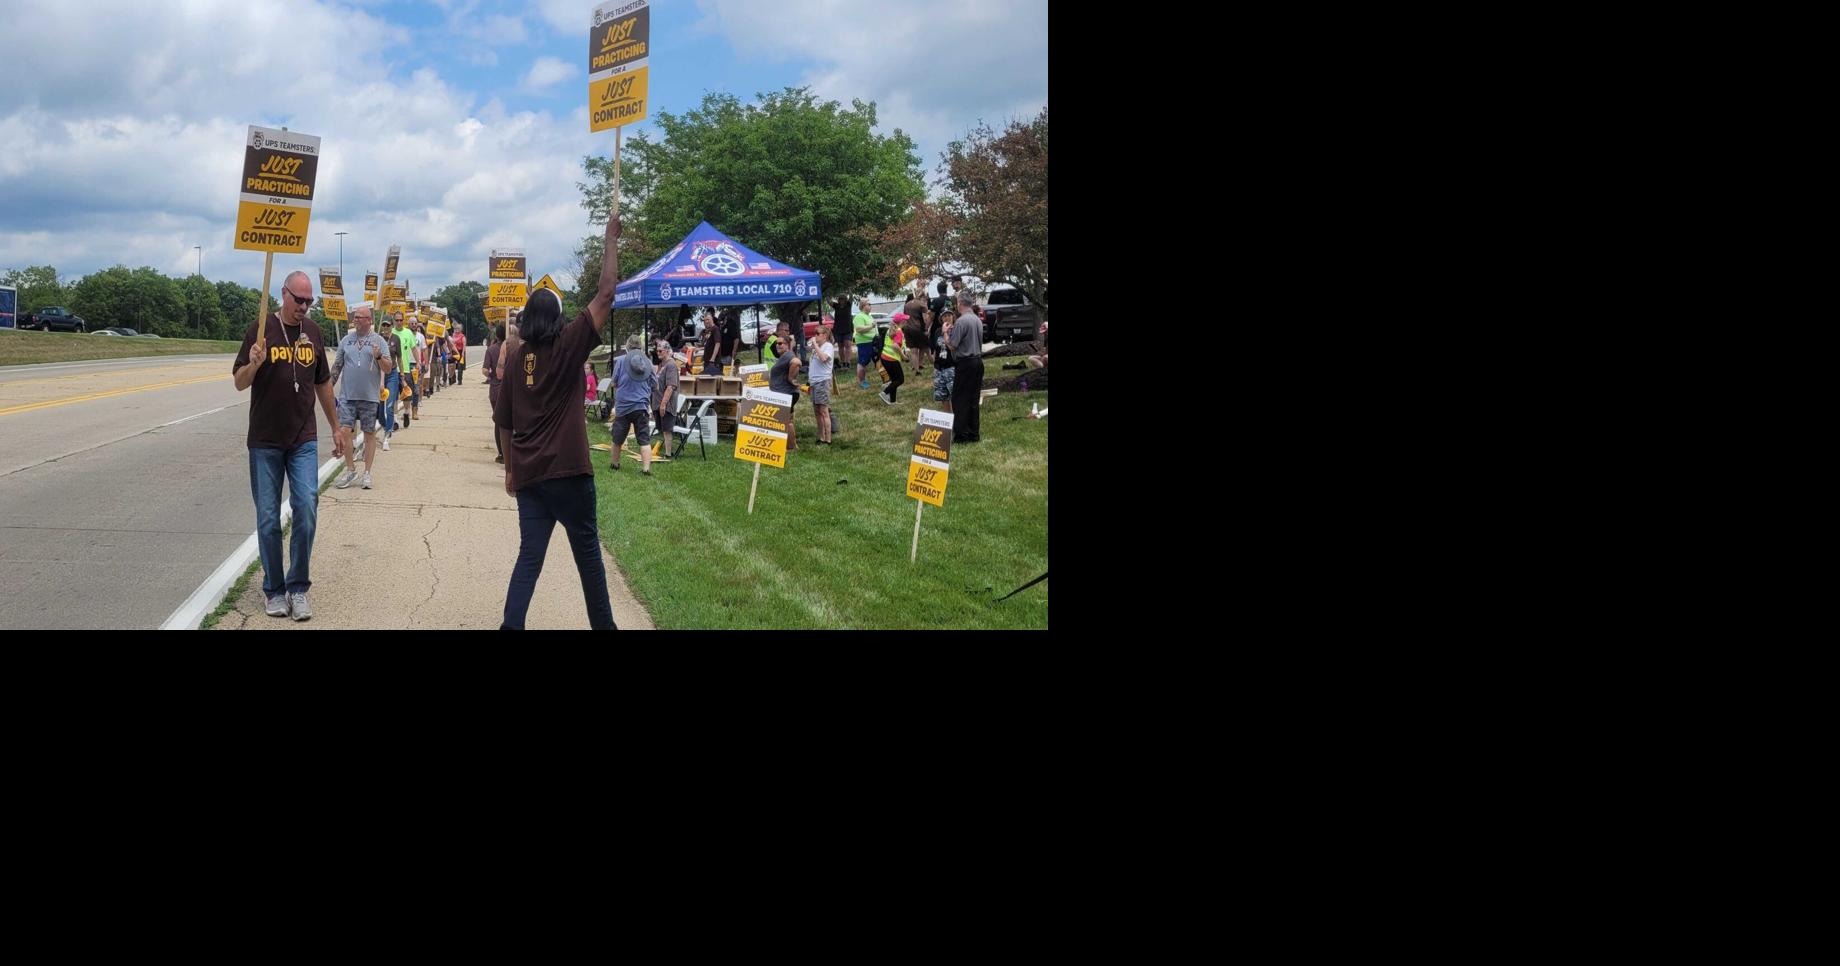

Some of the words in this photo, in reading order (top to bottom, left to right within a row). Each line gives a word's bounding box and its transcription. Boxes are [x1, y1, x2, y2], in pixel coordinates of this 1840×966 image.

[603, 11, 614, 20] UPS
[602, 17, 637, 46] JUST
[592, 41, 646, 69] PRACTICING
[601, 76, 636, 101] JUST
[593, 100, 643, 124] CONTRACT
[265, 139, 278, 148] UPS
[261, 155, 303, 175] JUST
[247, 177, 310, 196] PRACTICING
[254, 208, 296, 226] JUST
[241, 231, 302, 247] CONTRACT
[496, 259, 518, 268] JUST
[497, 285, 517, 294] JUST
[674, 286, 735, 297] TEAMSTERS
[737, 285, 771, 295] LOCAL
[773, 284, 792, 294] 710
[270, 345, 293, 364] pay
[297, 345, 314, 364] up
[746, 372, 763, 381] JUST
[751, 403, 780, 417] JUST
[742, 416, 785, 431] PRACTICING
[747, 435, 776, 449] JUST
[920, 428, 943, 443] JUST
[739, 447, 781, 463] CONTRACT
[914, 444, 947, 460] PRACTICING
[915, 467, 937, 482] JUST
[909, 482, 941, 500] CONTRACT
